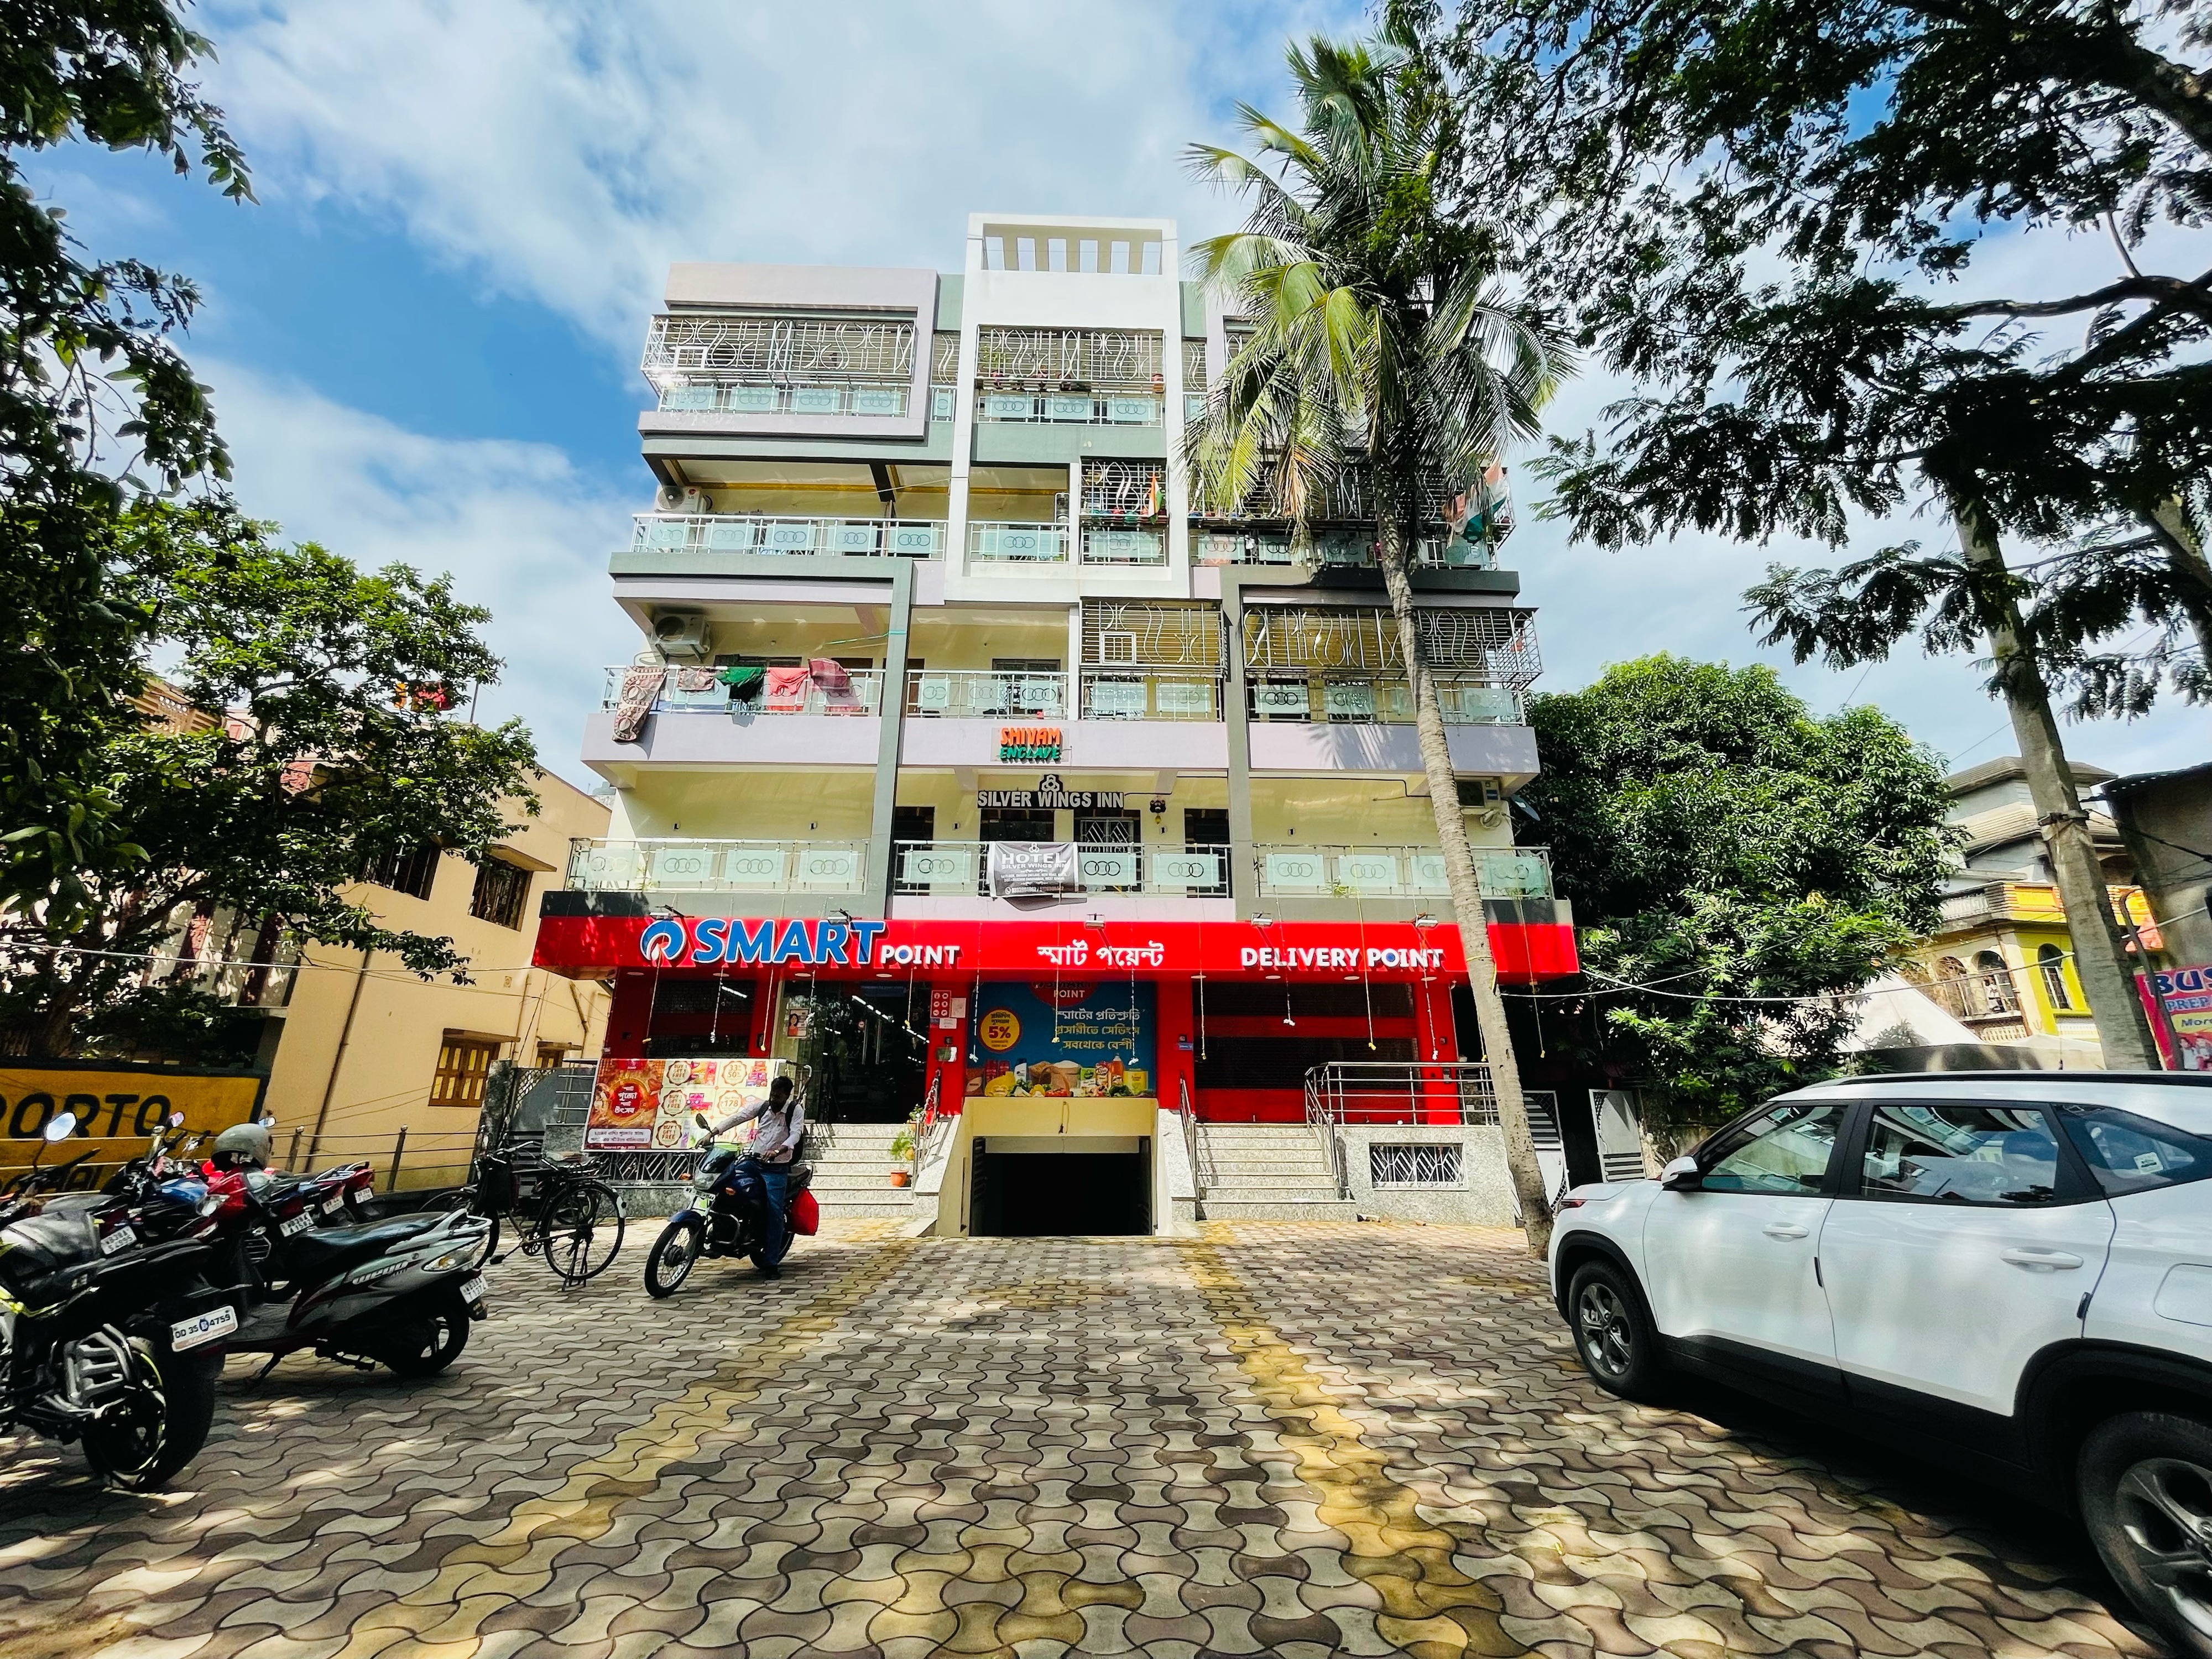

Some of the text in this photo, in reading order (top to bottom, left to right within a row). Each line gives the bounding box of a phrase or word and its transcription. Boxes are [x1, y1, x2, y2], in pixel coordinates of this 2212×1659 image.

[1000, 727, 1061, 745] SHIVAM
[1000, 746, 1061, 760] ENCLAVE
[978, 792, 1123, 807] SILVER WINGS INN
[1001, 853, 1066, 864] HOTEL
[691, 919, 961, 965] SMART POINT
[1037, 939, 1165, 967] স্মার্ট পয়েন্ট
[1241, 947, 1444, 968] DELIVERY POINT
[1053, 989, 1086, 998] POINT
[2167, 996, 2212, 1011] PREP
[988, 1026, 1011, 1039] 5%
[210, 1314, 231, 1326] 4759
